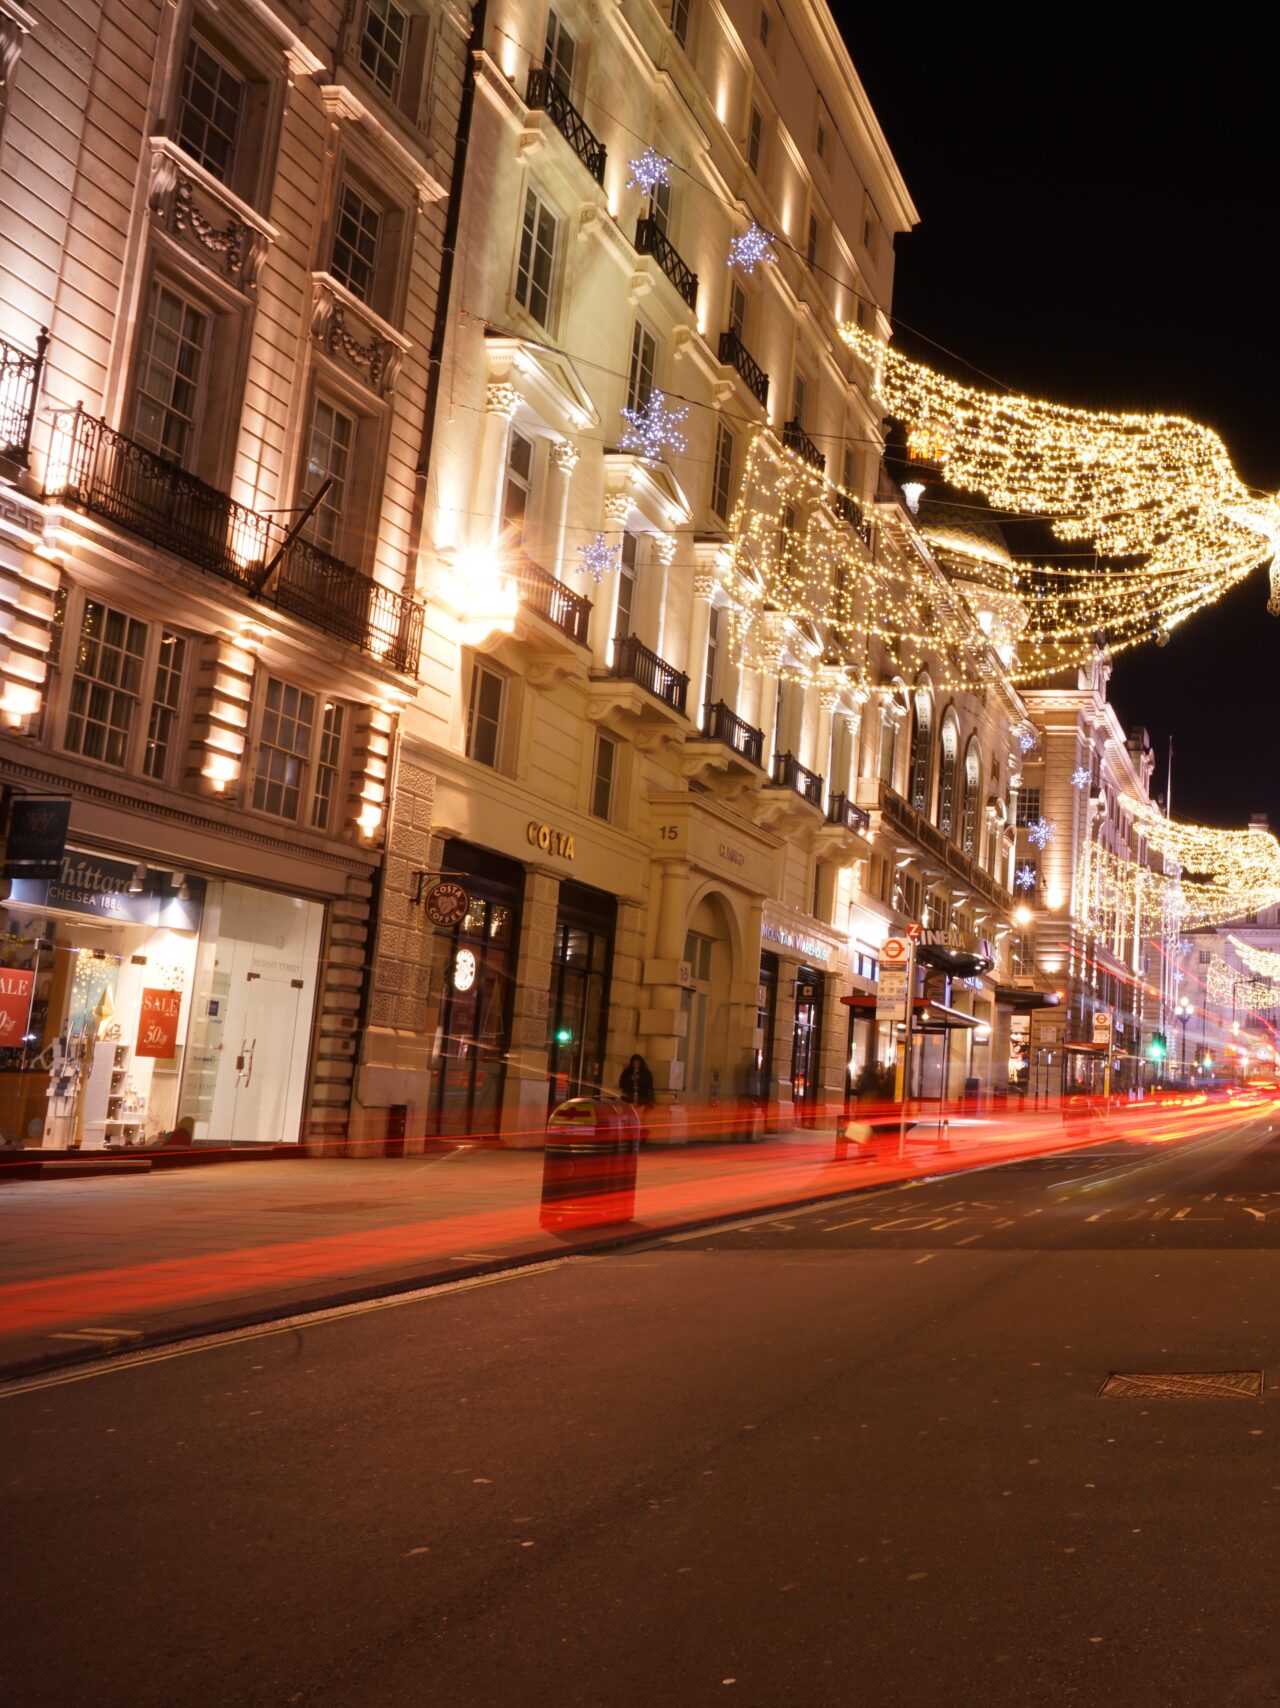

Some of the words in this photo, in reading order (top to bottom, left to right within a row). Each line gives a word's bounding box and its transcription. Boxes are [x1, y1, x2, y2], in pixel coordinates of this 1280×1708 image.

[526, 821, 576, 860] COSTA
[659, 826, 678, 840] 15
[59, 857, 137, 897] hittar
[49, 887, 96, 905] CHELSEA
[101, 896, 122, 911] 1886
[434, 885, 461, 898] COSTA
[430, 907, 463, 924] COFFEE
[762, 923, 794, 949] MOUNTAIN
[909, 924, 919, 936] Z
[917, 930, 966, 949] INEMA
[143, 995, 179, 1012] SALE
[738, 1217, 1009, 1232] STOP
